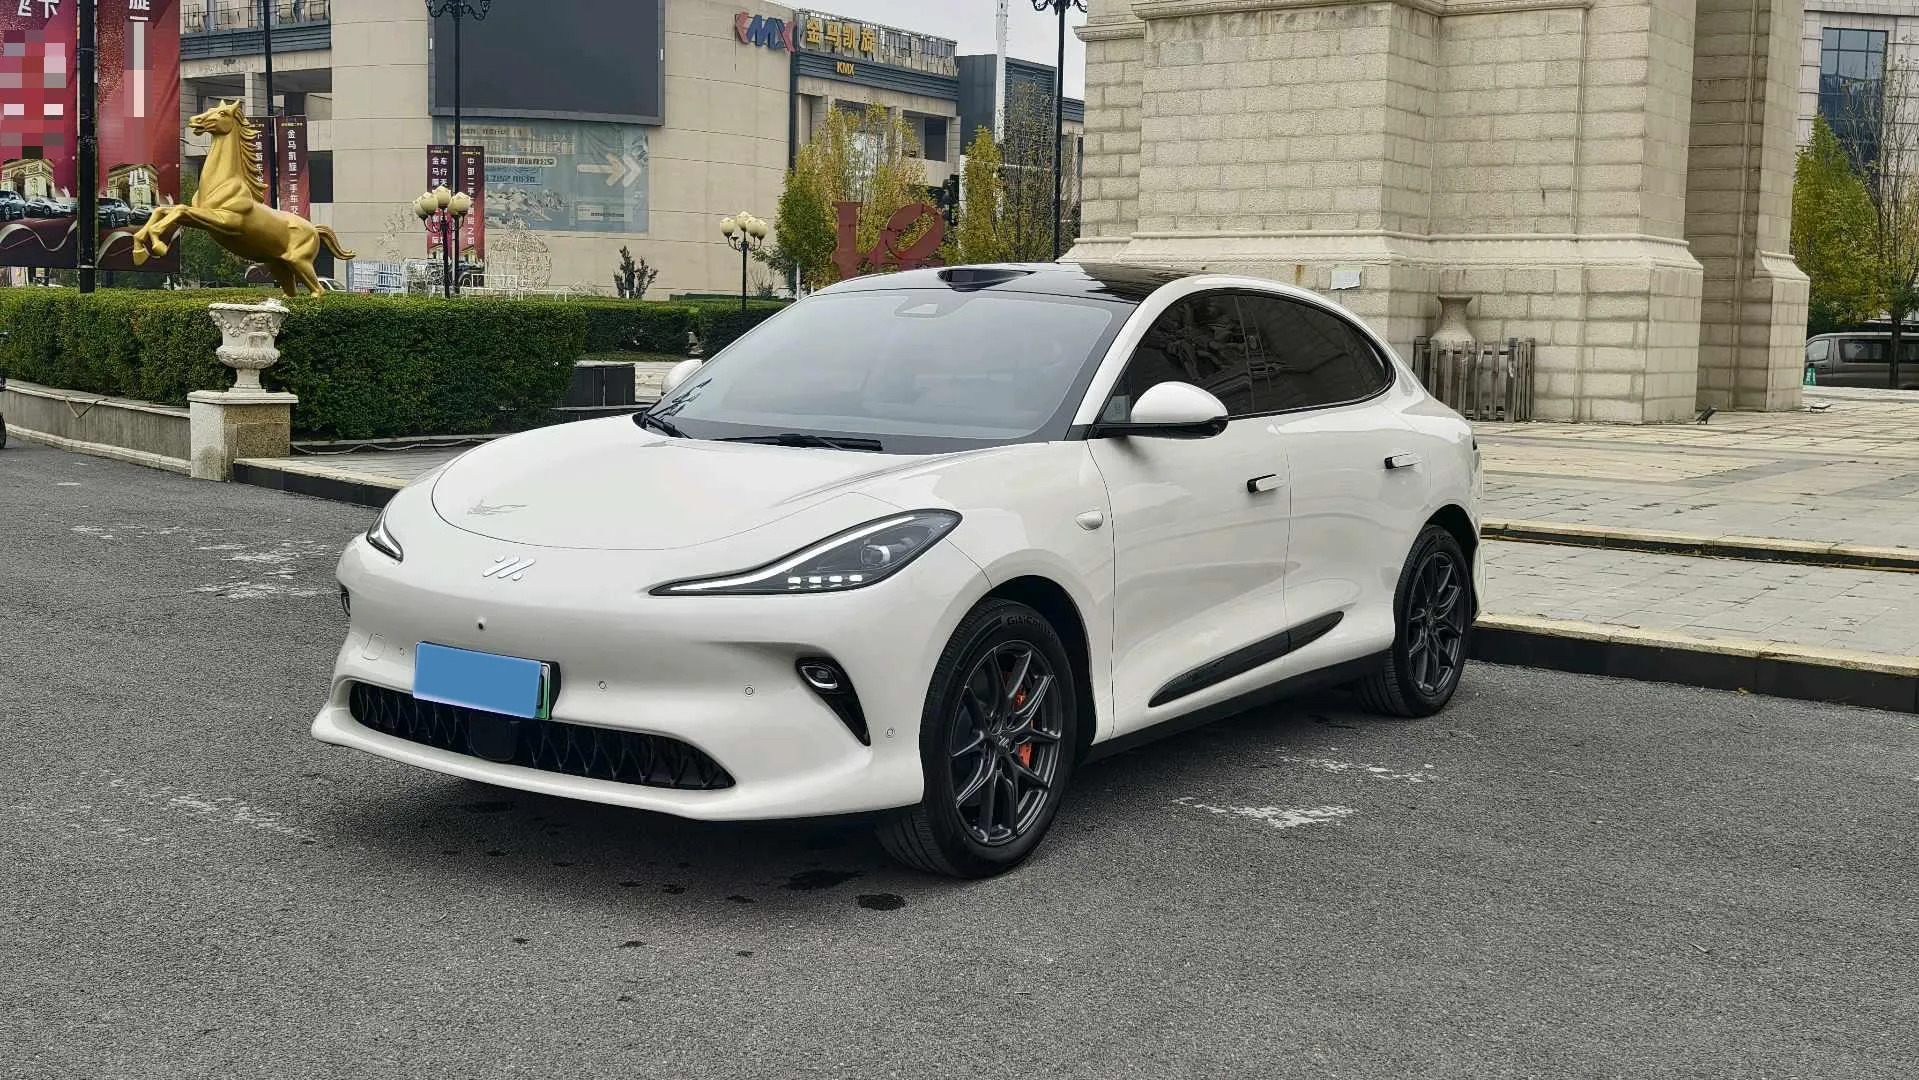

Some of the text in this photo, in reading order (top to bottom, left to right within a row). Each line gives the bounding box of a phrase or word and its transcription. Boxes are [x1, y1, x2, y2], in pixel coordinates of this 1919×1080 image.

[806, 17, 876, 52] 金马凯旋
[837, 61, 855, 76] KMX
